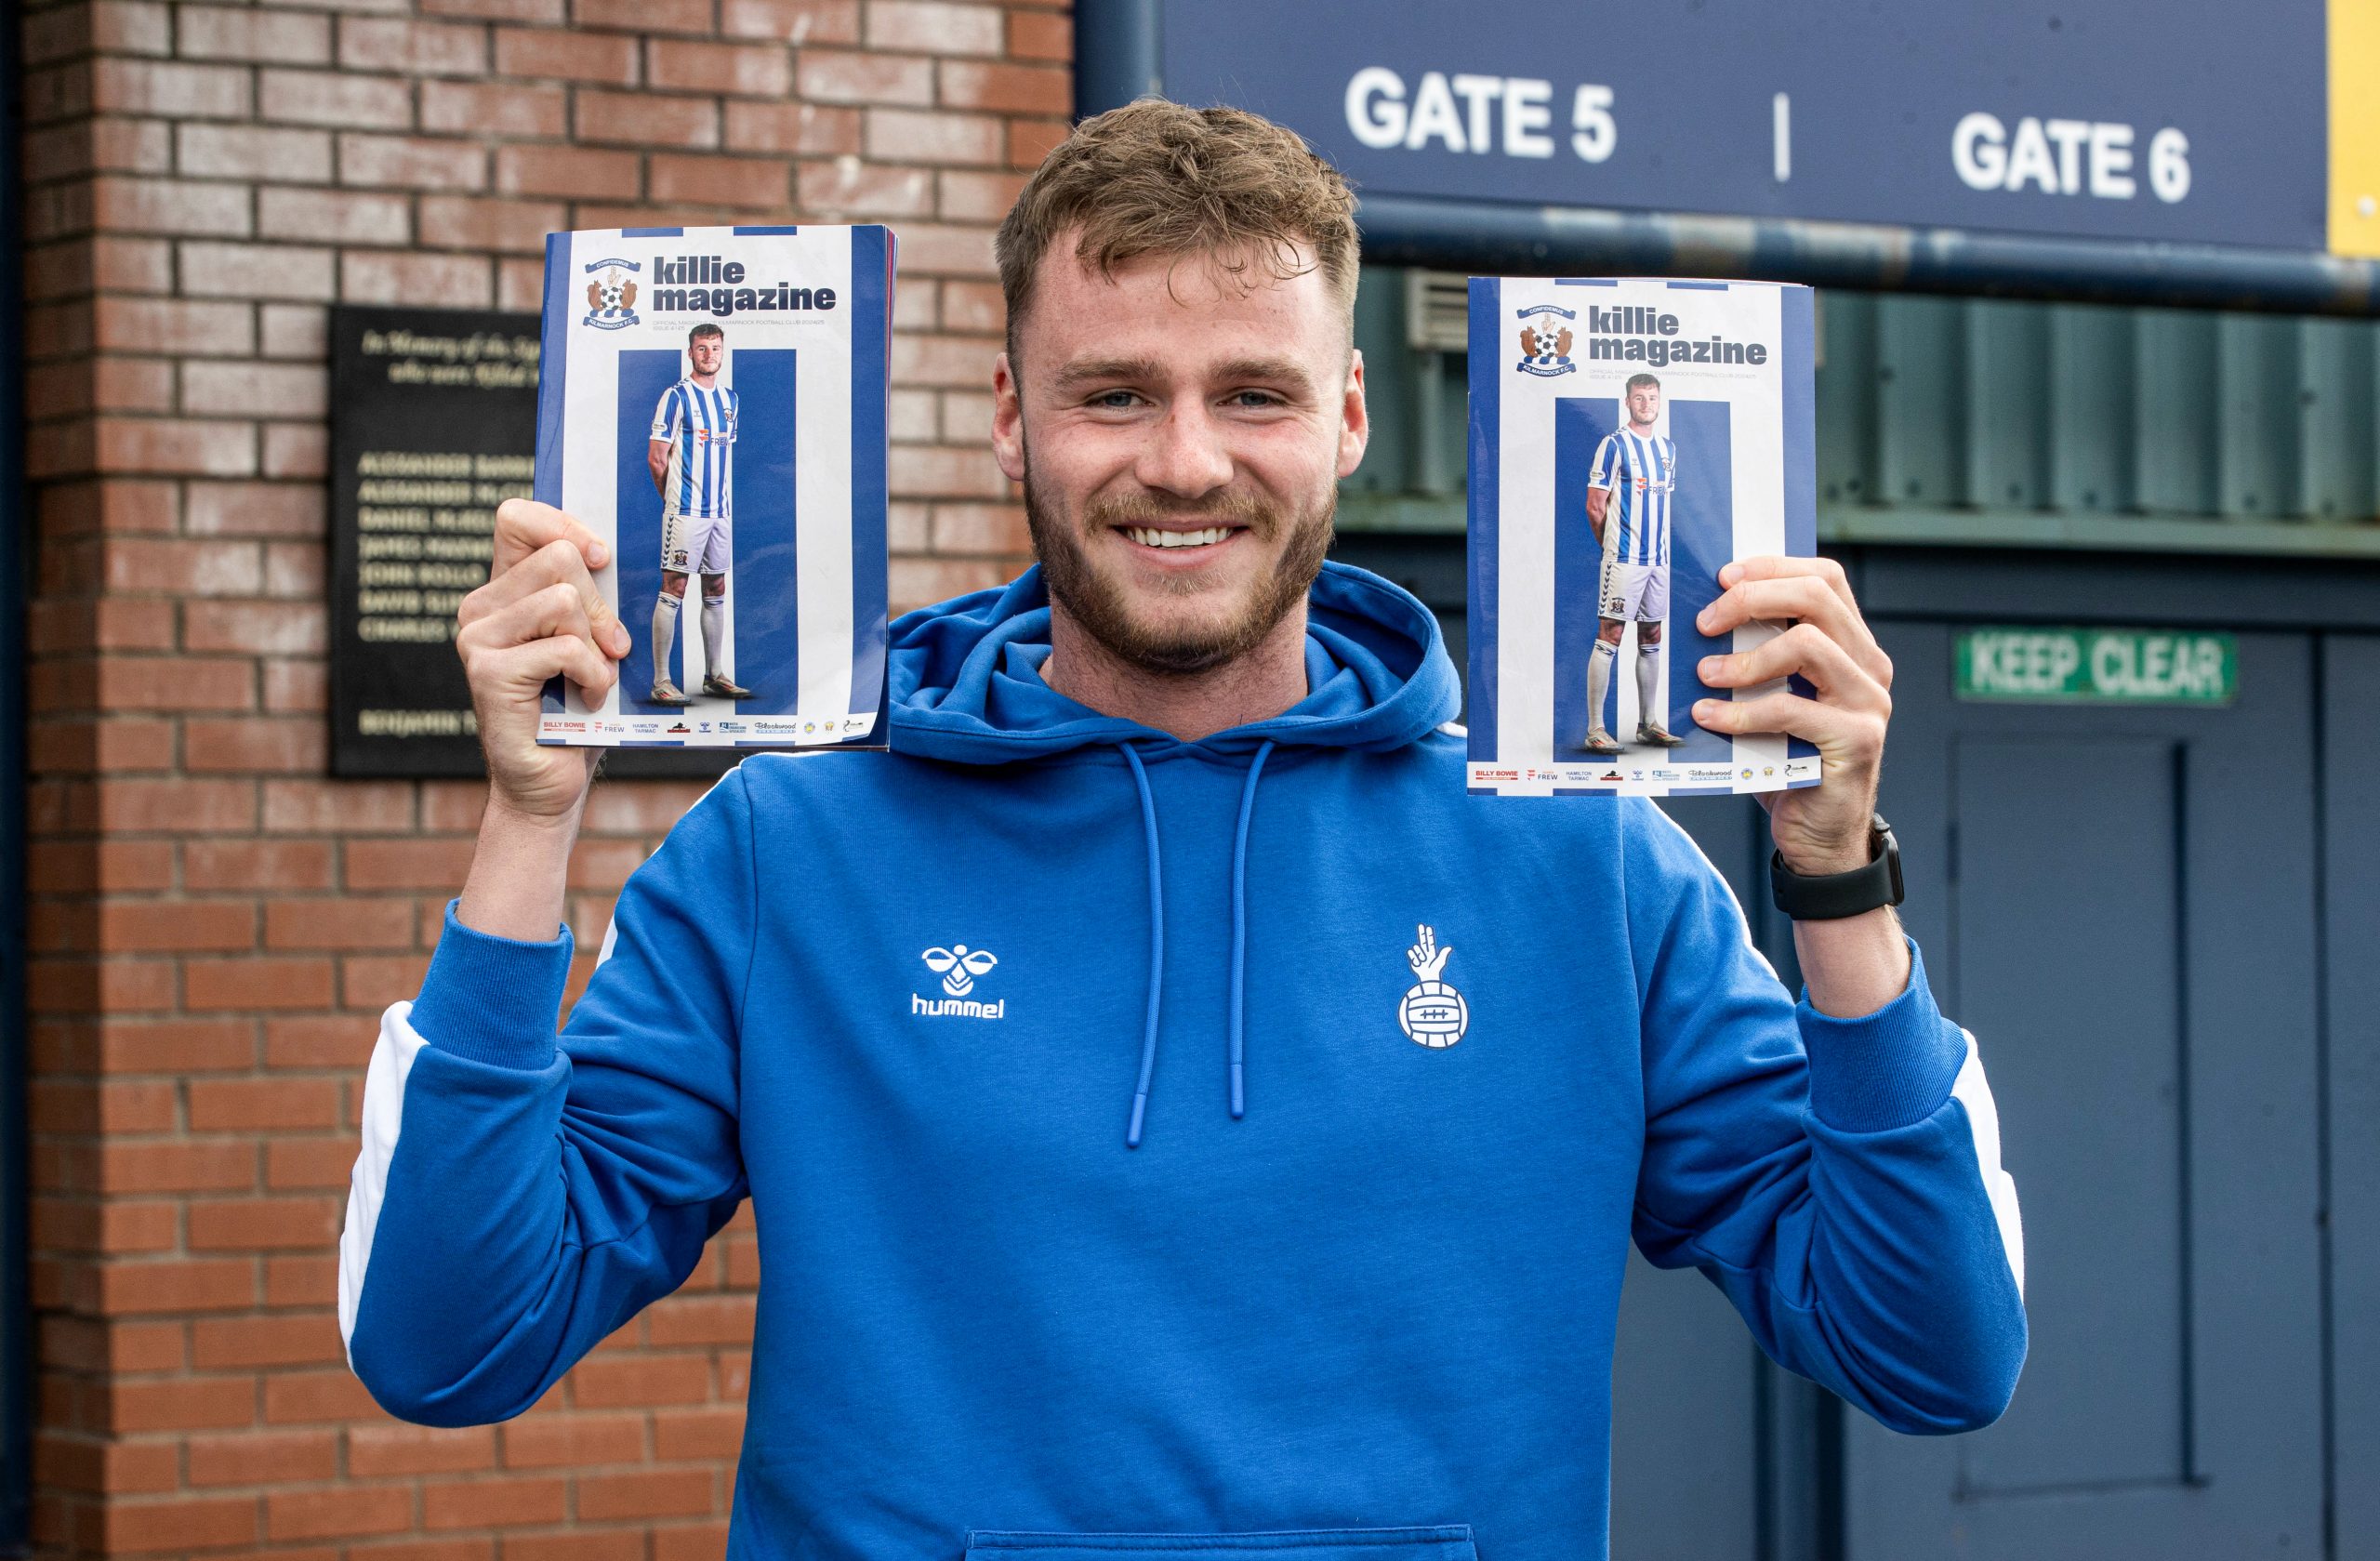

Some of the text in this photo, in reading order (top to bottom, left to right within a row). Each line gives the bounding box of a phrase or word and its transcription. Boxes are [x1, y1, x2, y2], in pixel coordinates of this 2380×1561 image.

[1344, 66, 1617, 164] GATE 5
[1950, 111, 2190, 204] GATE 6
[596, 258, 629, 269] CONFIDEMUS
[654, 256, 745, 284] killie
[653, 282, 836, 317] magazine
[1528, 305, 1564, 315] CONFIDEMUS
[588, 319, 624, 330] KILMARNOCK
[1589, 305, 1679, 336] killie
[1589, 336, 1767, 367] magazine
[1523, 364, 1560, 377] KILMARNOCK
[1972, 633, 2224, 696] KEEP CLEAR
[754, 721, 797, 730] Blackwood
[912, 993, 1004, 1019] hummel
